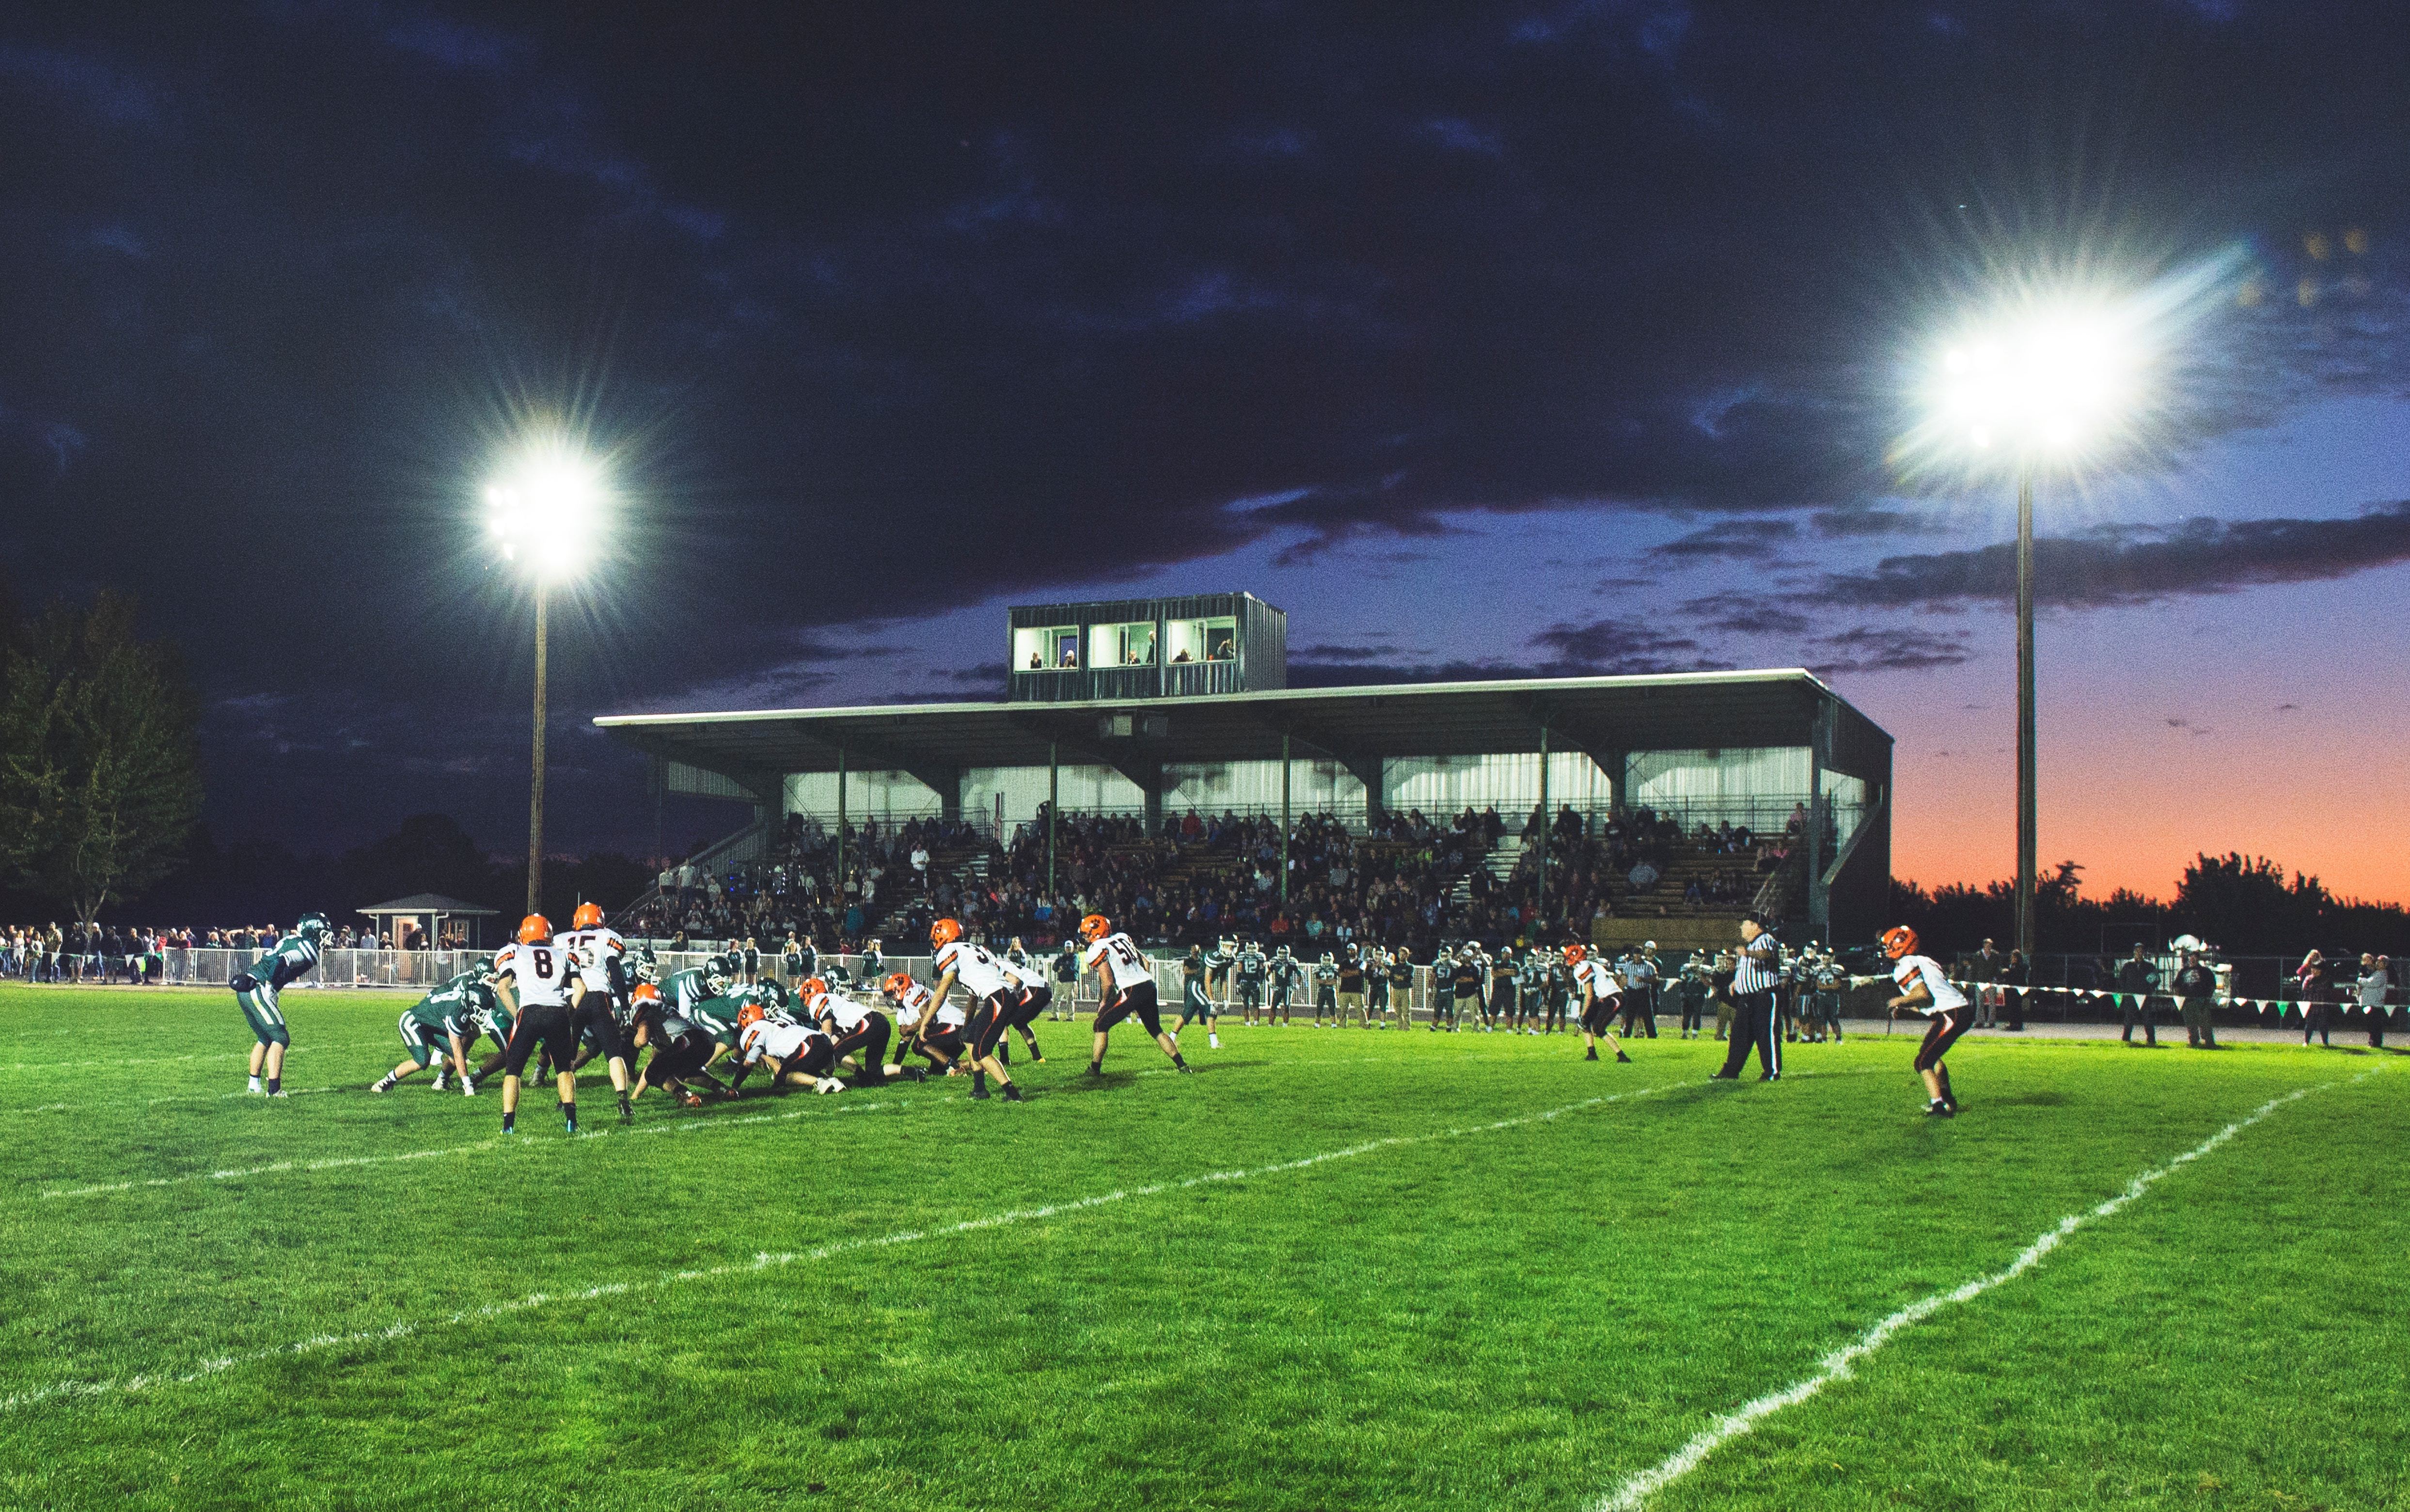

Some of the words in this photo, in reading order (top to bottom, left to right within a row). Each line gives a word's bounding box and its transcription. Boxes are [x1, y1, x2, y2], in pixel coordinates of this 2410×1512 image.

[533, 949, 553, 979] 8
[1244, 958, 1258, 973] 12
[1278, 966, 1286, 978] 4
